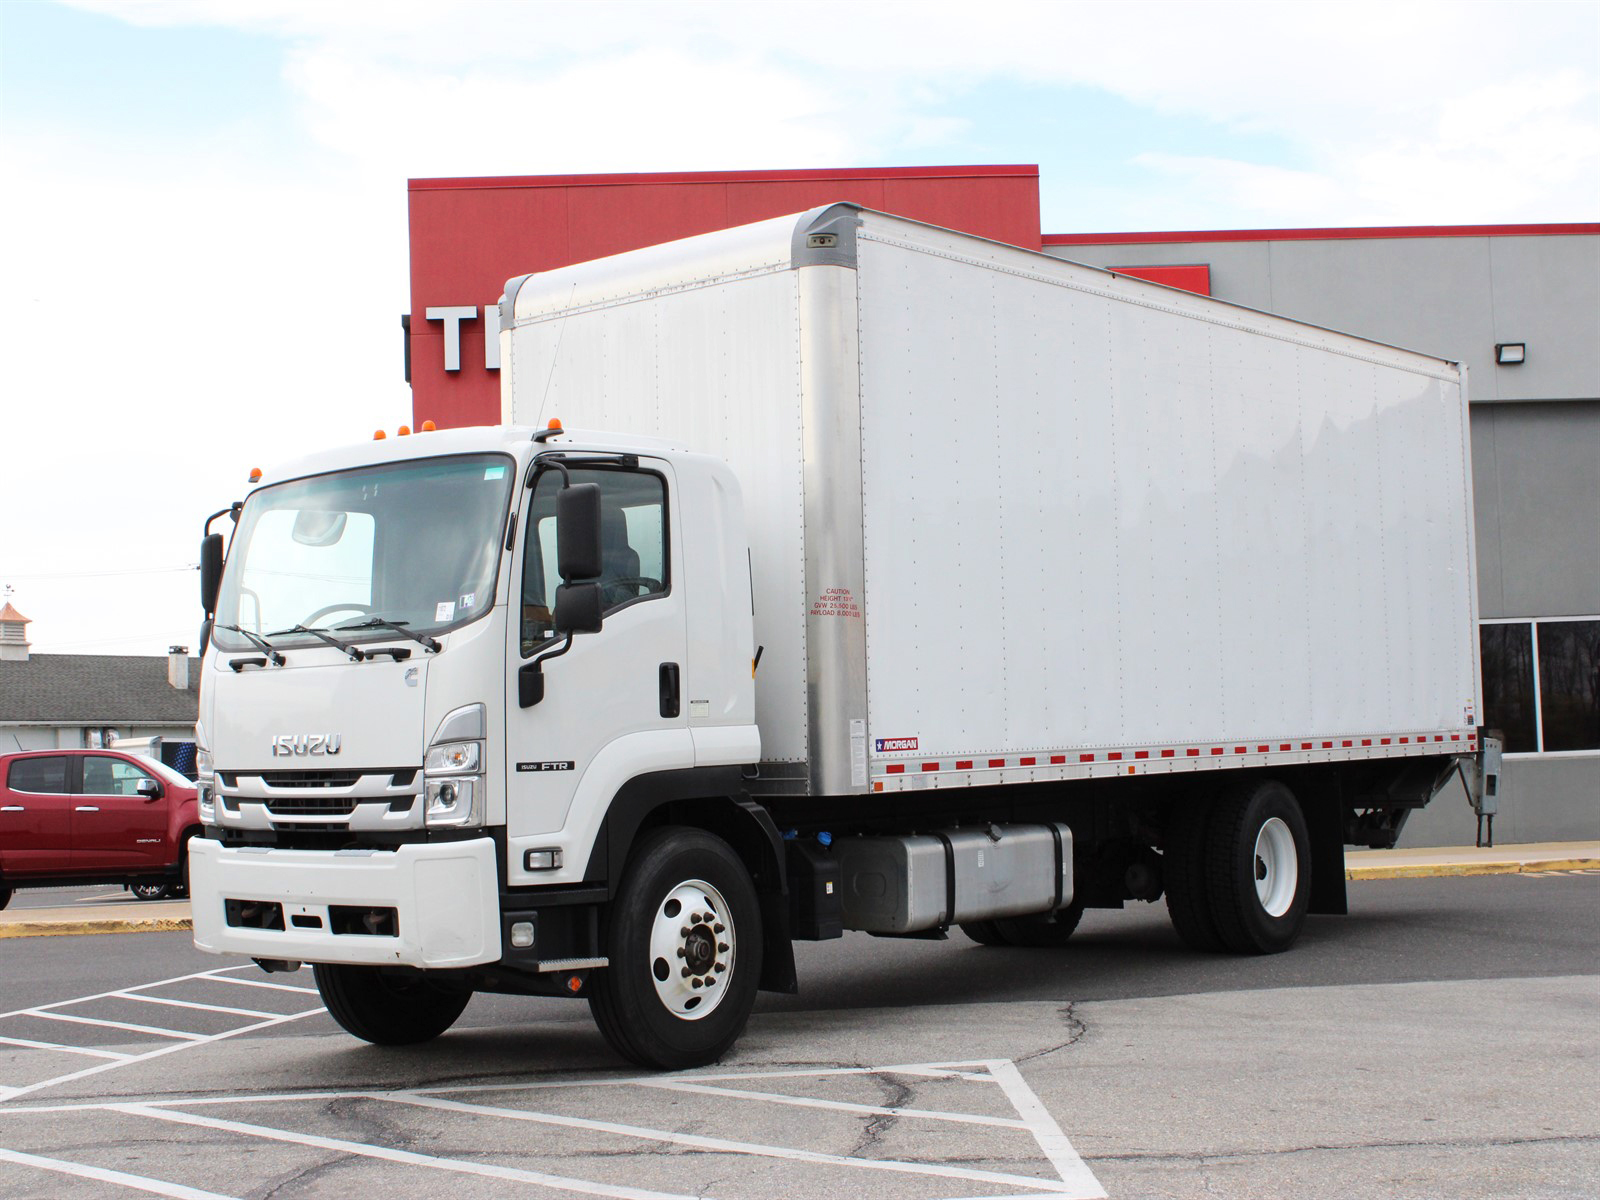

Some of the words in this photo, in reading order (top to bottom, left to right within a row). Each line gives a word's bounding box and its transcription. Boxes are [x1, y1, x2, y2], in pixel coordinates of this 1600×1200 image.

[272, 732, 342, 757] ISUZU
[883, 739, 917, 750] MORGAN
[541, 762, 568, 771] FTR
